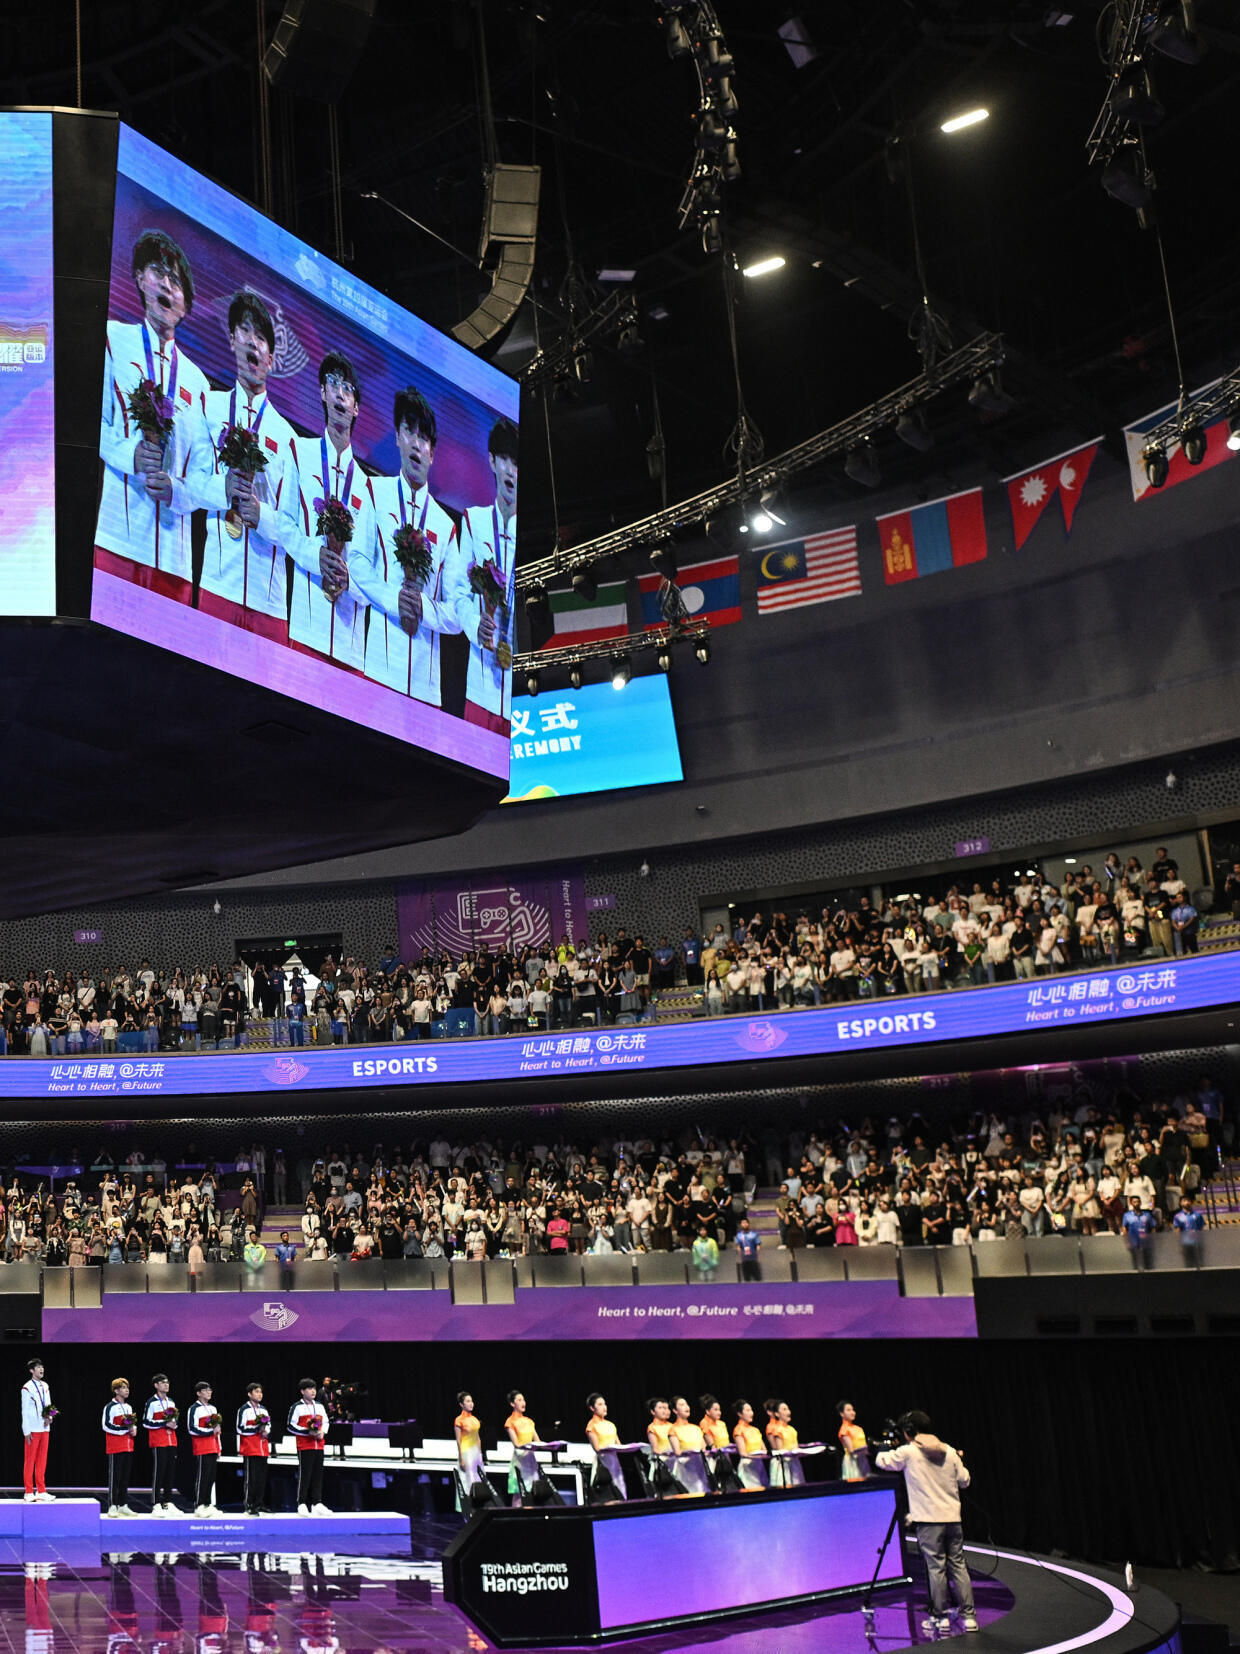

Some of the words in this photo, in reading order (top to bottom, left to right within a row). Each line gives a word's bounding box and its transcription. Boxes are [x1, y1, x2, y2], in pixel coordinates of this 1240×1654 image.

[963, 841, 982, 853] 312
[562, 880, 572, 906] Heart
[593, 898, 610, 907] 311
[564, 908, 572, 918] to
[80, 932, 97, 940] 310
[1025, 1009, 1059, 1022] Heart
[1063, 1007, 1076, 1018] to
[1080, 1002, 1120, 1013] Heart,
[1122, 995, 1176, 1009] @Future
[837, 1011, 936, 1040] ESPORTS
[353, 1056, 438, 1077] ESPORTS
[520, 1061, 547, 1071] Heart
[551, 1060, 561, 1068] to
[565, 1057, 598, 1067] Heart,
[600, 1054, 645, 1064] @Future
[48, 1083, 75, 1091] Heart
[77, 1083, 86, 1091] to
[90, 1082, 120, 1092] Heart,
[122, 1081, 163, 1090] @Future
[598, 1306, 630, 1317] Heart
[634, 1307, 646, 1317] to
[648, 1306, 685, 1318] Heart,
[687, 1305, 738, 1316] @Future
[480, 1563, 504, 1575] 19th
[505, 1562, 533, 1574] Asian
[533, 1562, 568, 1573] Games
[482, 1574, 569, 1594] Hangzhou
